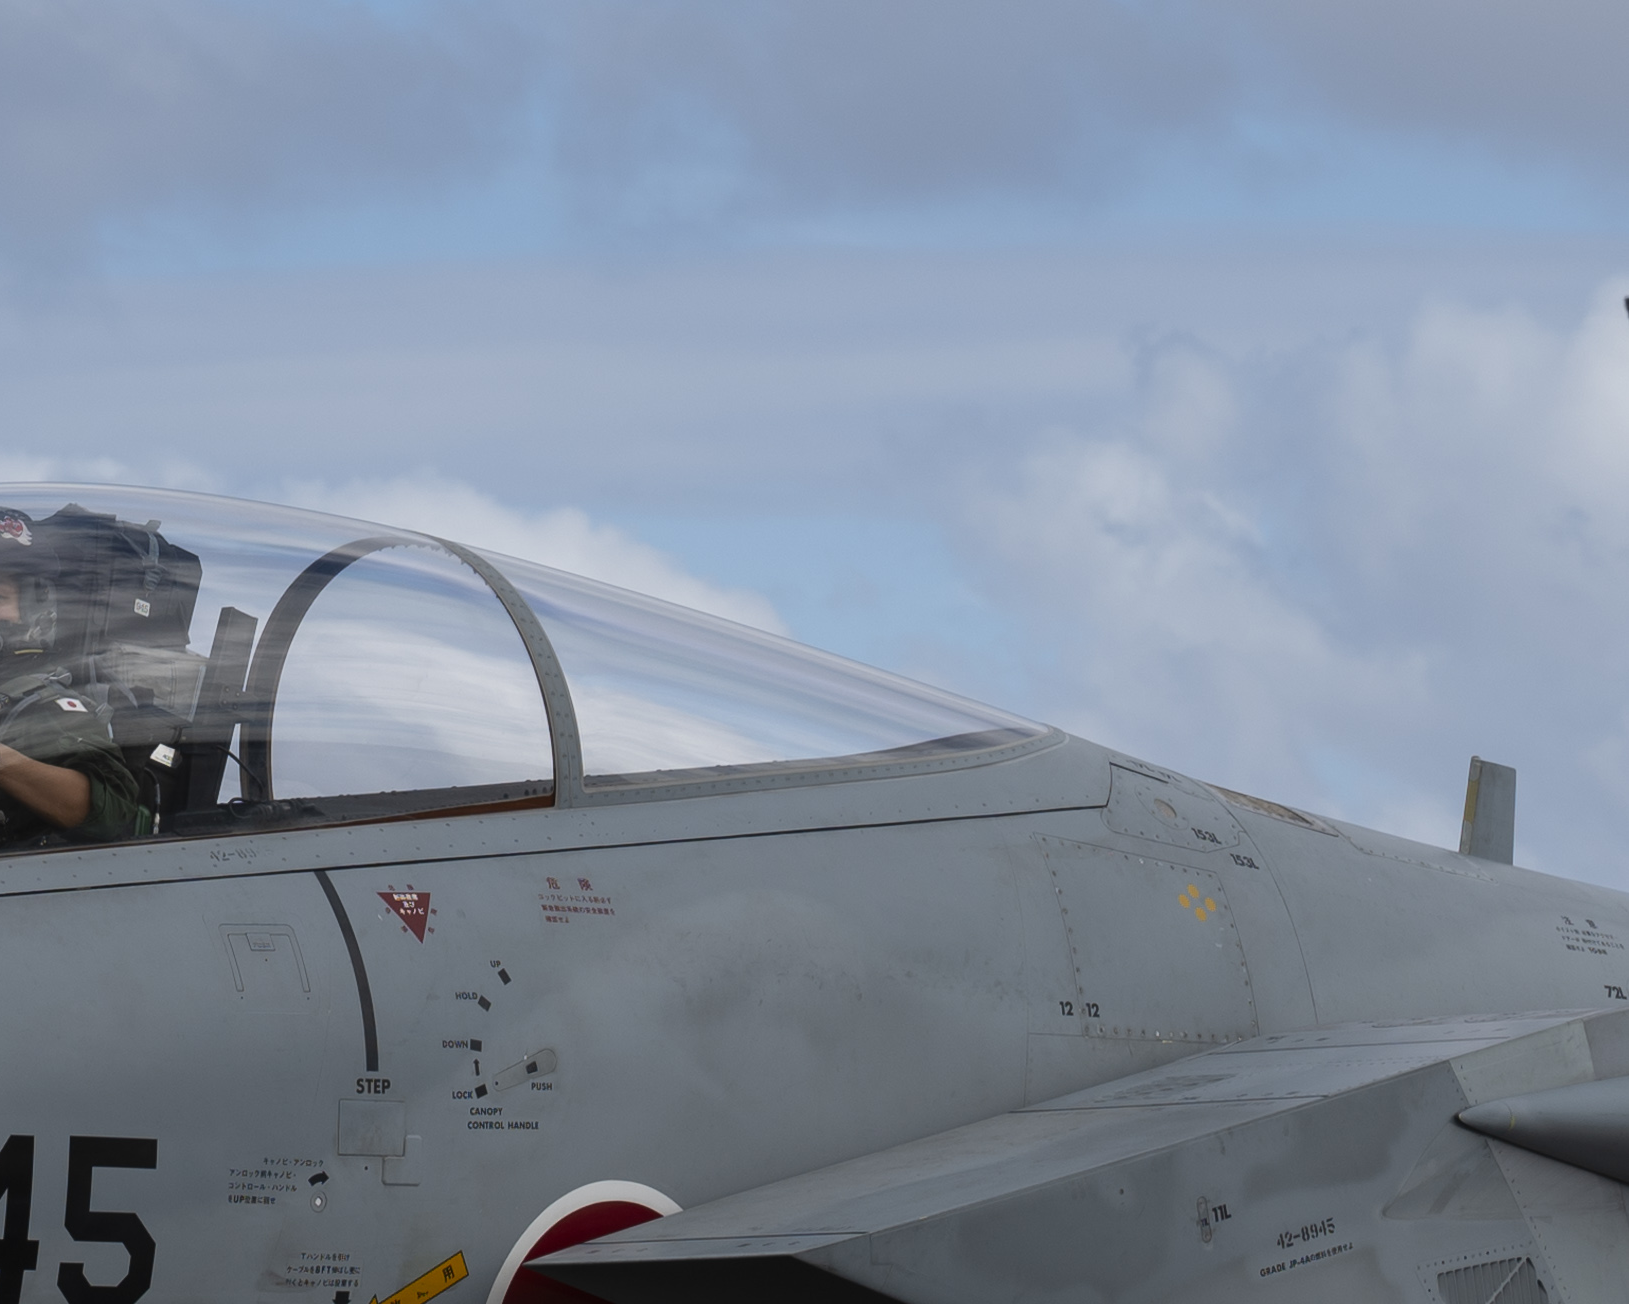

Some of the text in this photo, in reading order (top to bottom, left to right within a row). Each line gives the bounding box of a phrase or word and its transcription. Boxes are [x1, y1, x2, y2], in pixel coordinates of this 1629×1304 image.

[1191, 827, 1222, 846] 153L
[1229, 853, 1260, 870] 153L
[489, 959, 502, 968] UP
[455, 991, 479, 1001] HOLD
[1059, 1001, 1074, 1017] 12
[1085, 1002, 1101, 1018] 12
[442, 1039, 469, 1050] DOWN
[355, 1078, 391, 1095] STEP
[531, 1081, 553, 1091] PUSH
[452, 1090, 474, 1100] LOCK
[469, 1106, 503, 1117] CANOPY
[467, 1120, 540, 1131] CONTROL HANDLE
[1276, 1216, 1336, 1250] 42-8945
[1259, 1261, 1287, 1278] GRADE
